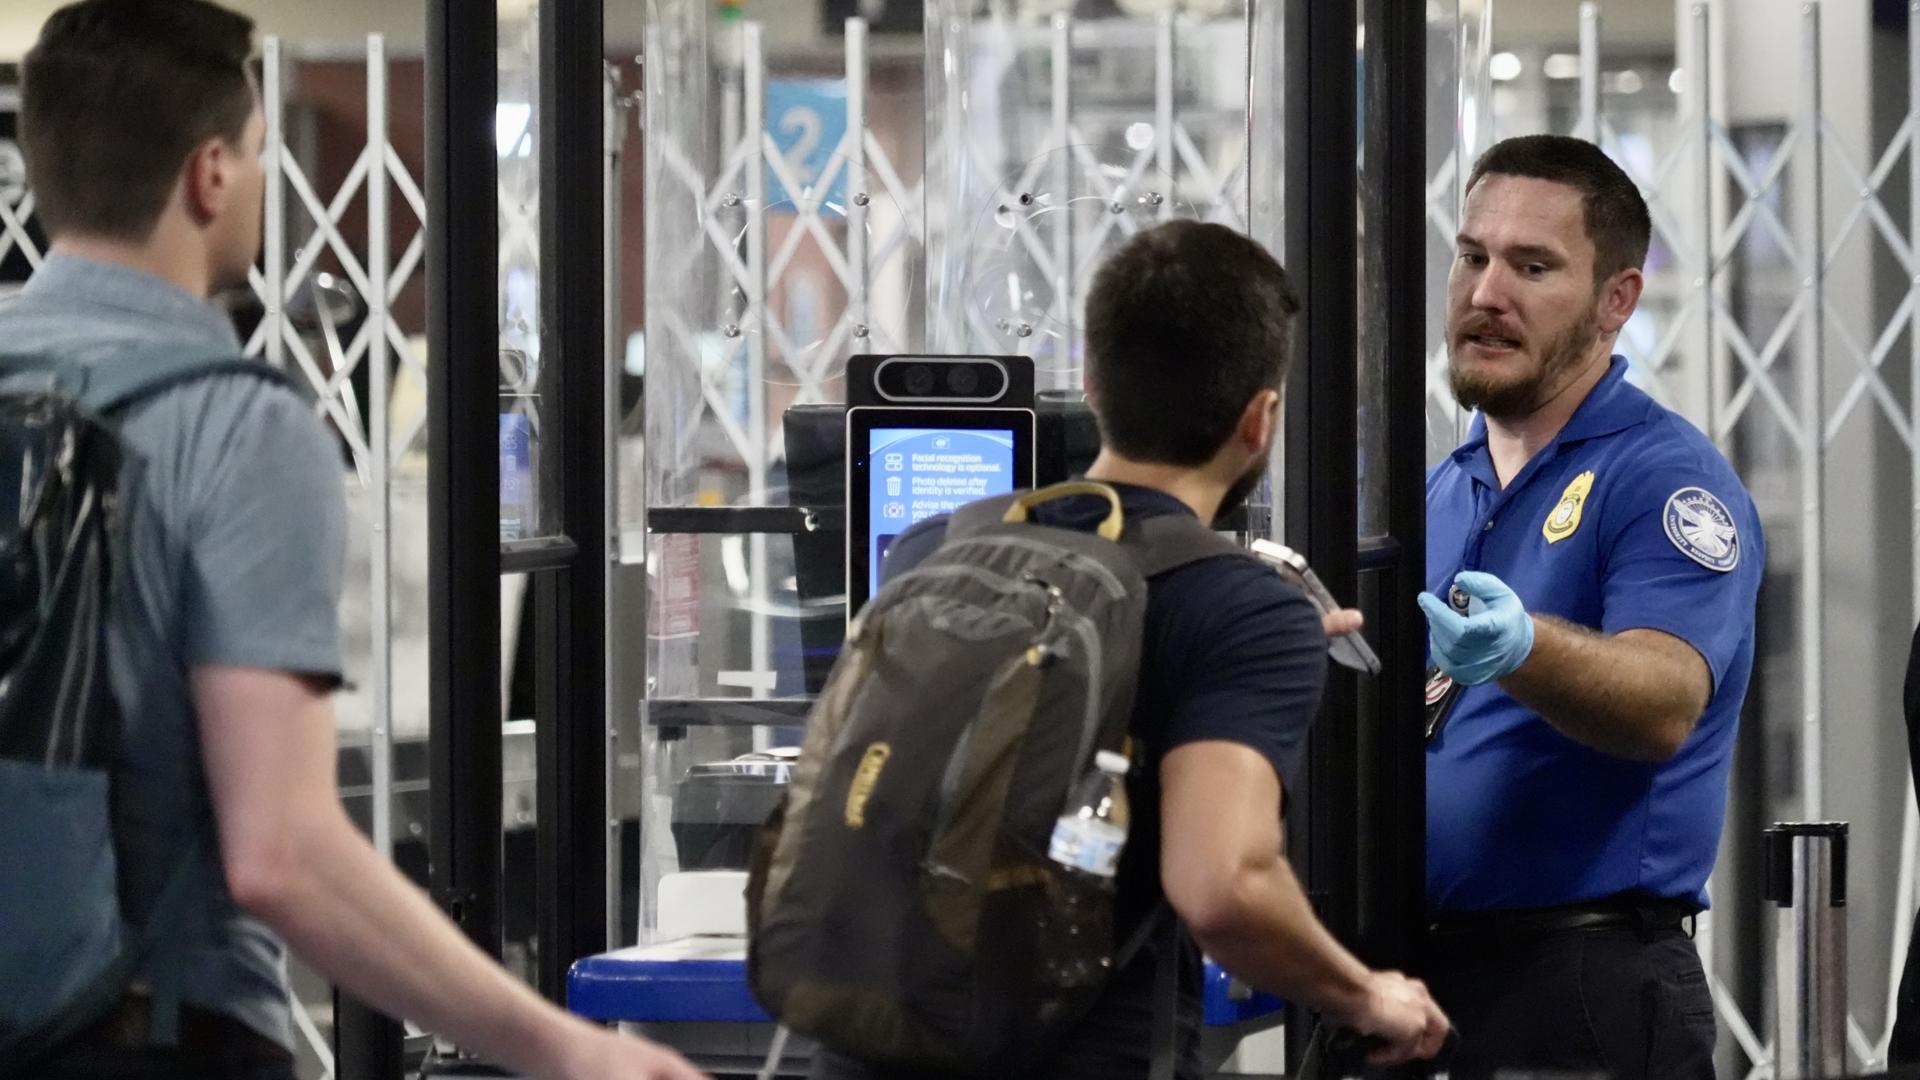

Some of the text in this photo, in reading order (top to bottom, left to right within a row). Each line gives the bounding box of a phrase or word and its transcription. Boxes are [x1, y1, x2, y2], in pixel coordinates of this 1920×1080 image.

[779, 105, 822, 183] 2
[912, 453, 982, 464] Facial recognition
[912, 463, 1001, 473] technology is optional.
[912, 476, 989, 487] Photo deleted after
[912, 486, 986, 497] identity is verified.
[912, 500, 940, 510] Advise
[940, 500, 955, 510] the
[912, 510, 928, 520] you
